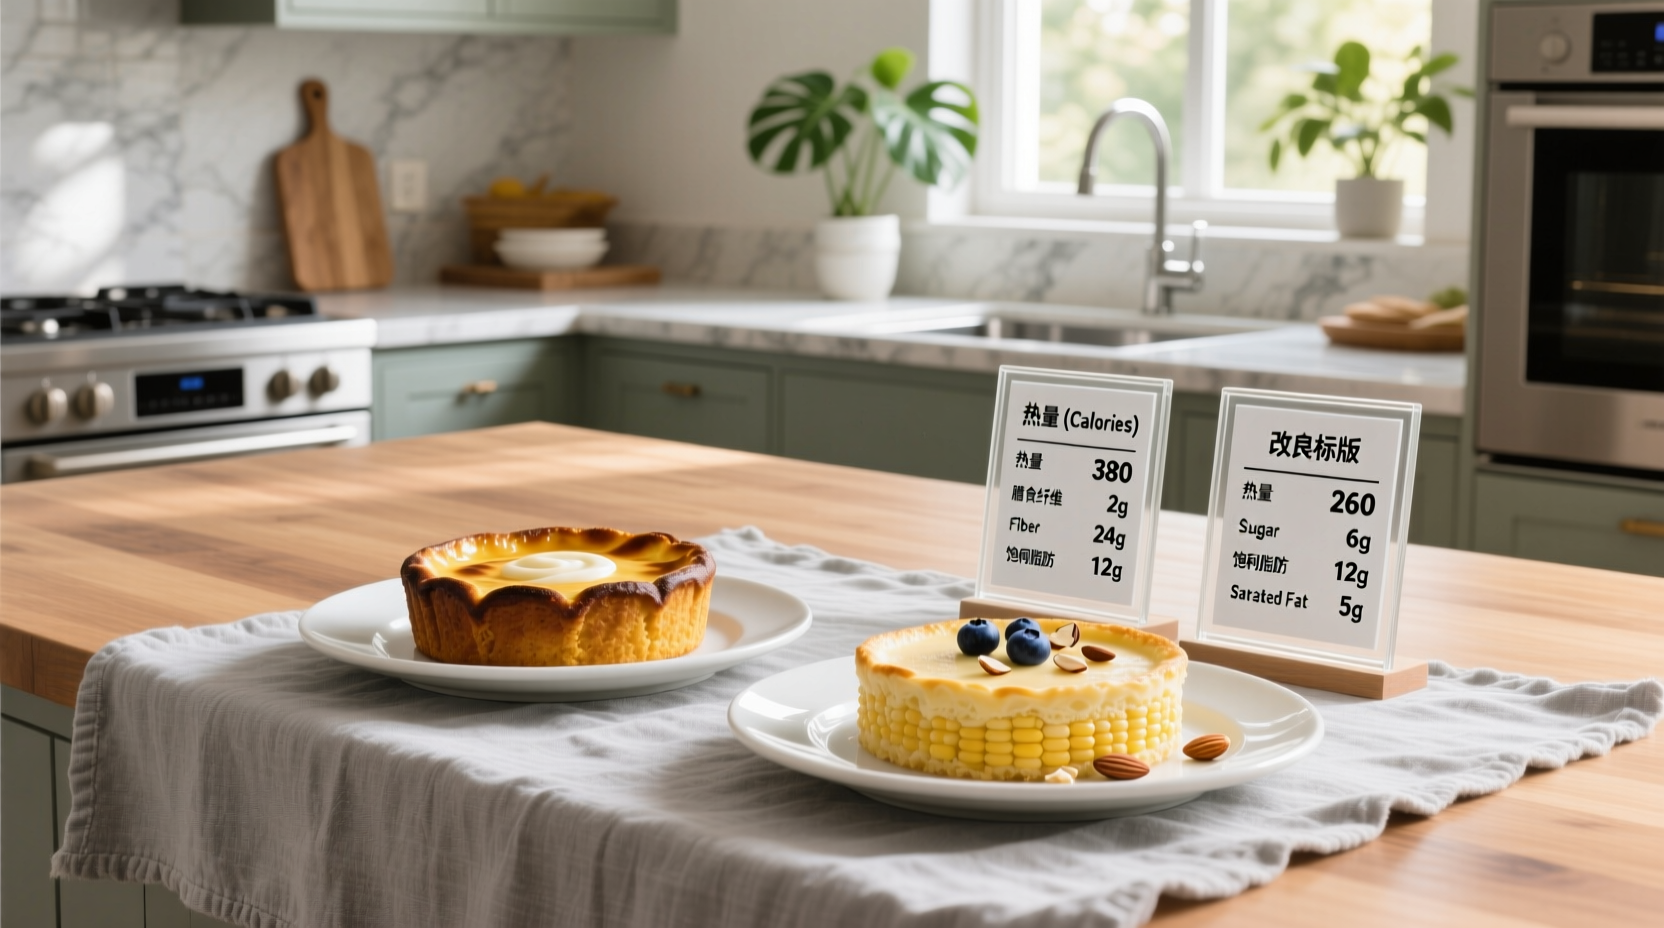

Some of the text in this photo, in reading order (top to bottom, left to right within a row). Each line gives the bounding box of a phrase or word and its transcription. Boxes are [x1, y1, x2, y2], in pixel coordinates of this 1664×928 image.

[1023, 402, 1139, 438] 热量 (Calories)
[1269, 431, 1361, 464] 改良标版
[1016, 450, 1132, 483] 热量 380
[1107, 494, 1128, 519] 2g
[1242, 481, 1375, 516] 热量 260
[1093, 525, 1126, 550] 24g
[1239, 518, 1371, 554] Sugar 6g
[1092, 556, 1122, 582] 12g
[1335, 561, 1369, 589] 12g
[1286, 592, 1308, 608] Fat
[1339, 596, 1363, 623] 5g
